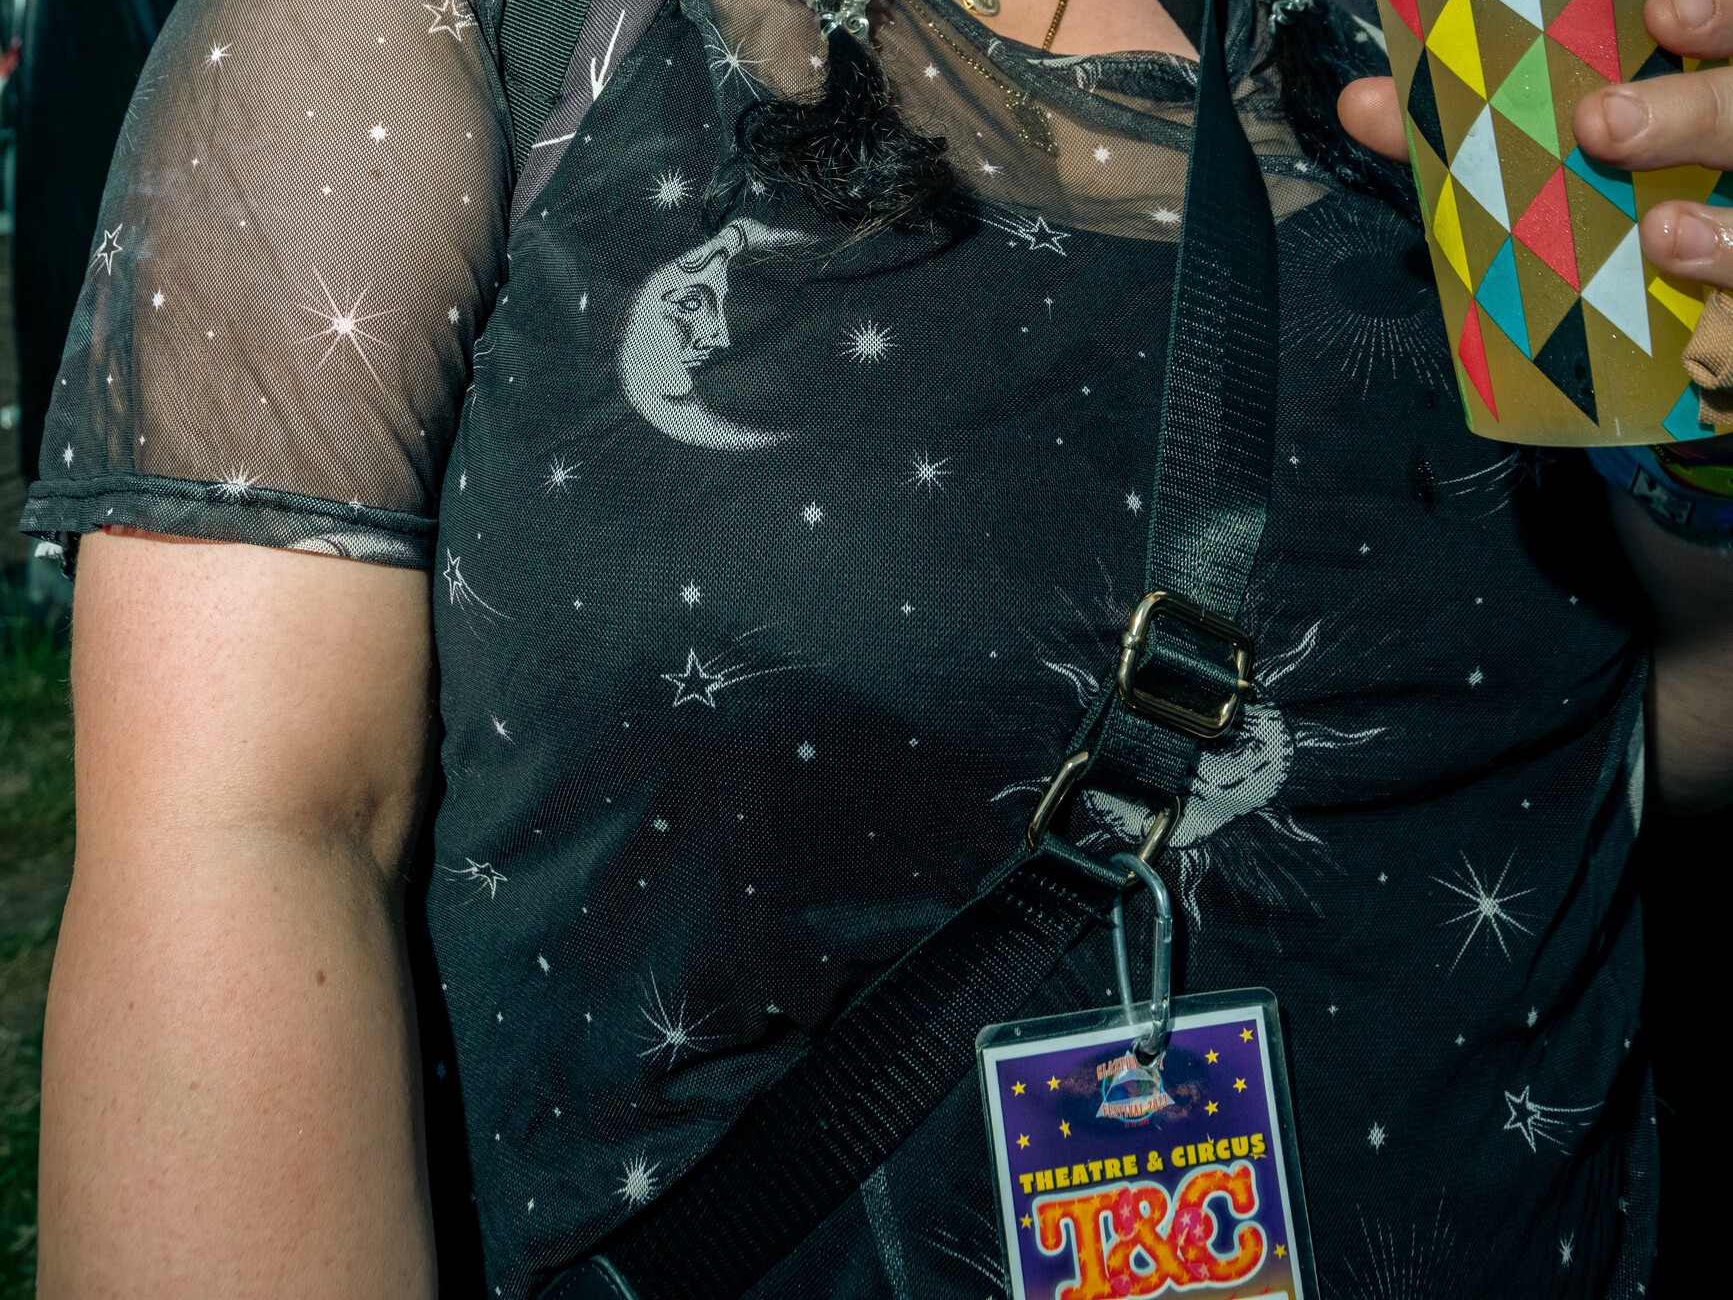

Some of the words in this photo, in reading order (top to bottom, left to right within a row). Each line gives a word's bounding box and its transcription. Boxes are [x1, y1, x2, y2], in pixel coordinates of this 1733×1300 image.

[1102, 1103, 1143, 1119] FESTIVAL
[1019, 1155, 1138, 1194] THEATRE
[1146, 1150, 1164, 1172] &
[1171, 1133, 1266, 1167] CIRCUS
